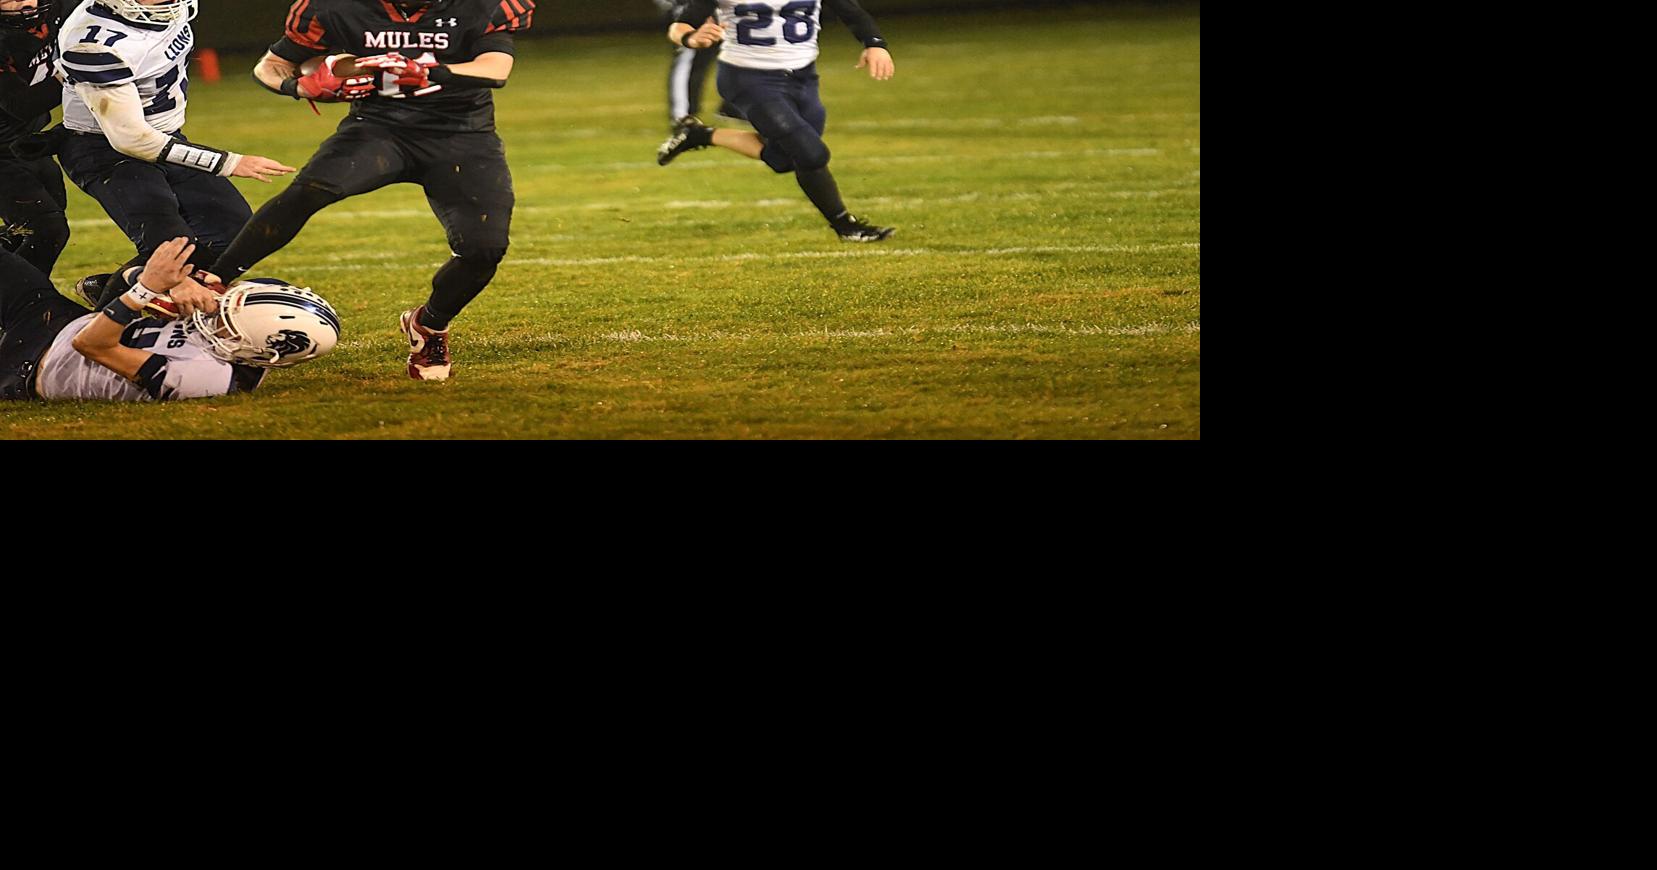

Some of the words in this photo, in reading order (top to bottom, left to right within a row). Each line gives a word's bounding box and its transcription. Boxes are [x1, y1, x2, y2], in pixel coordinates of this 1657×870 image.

[79, 25, 128, 47] 17
[164, 24, 191, 61] LIONS
[364, 31, 449, 49] MULES
